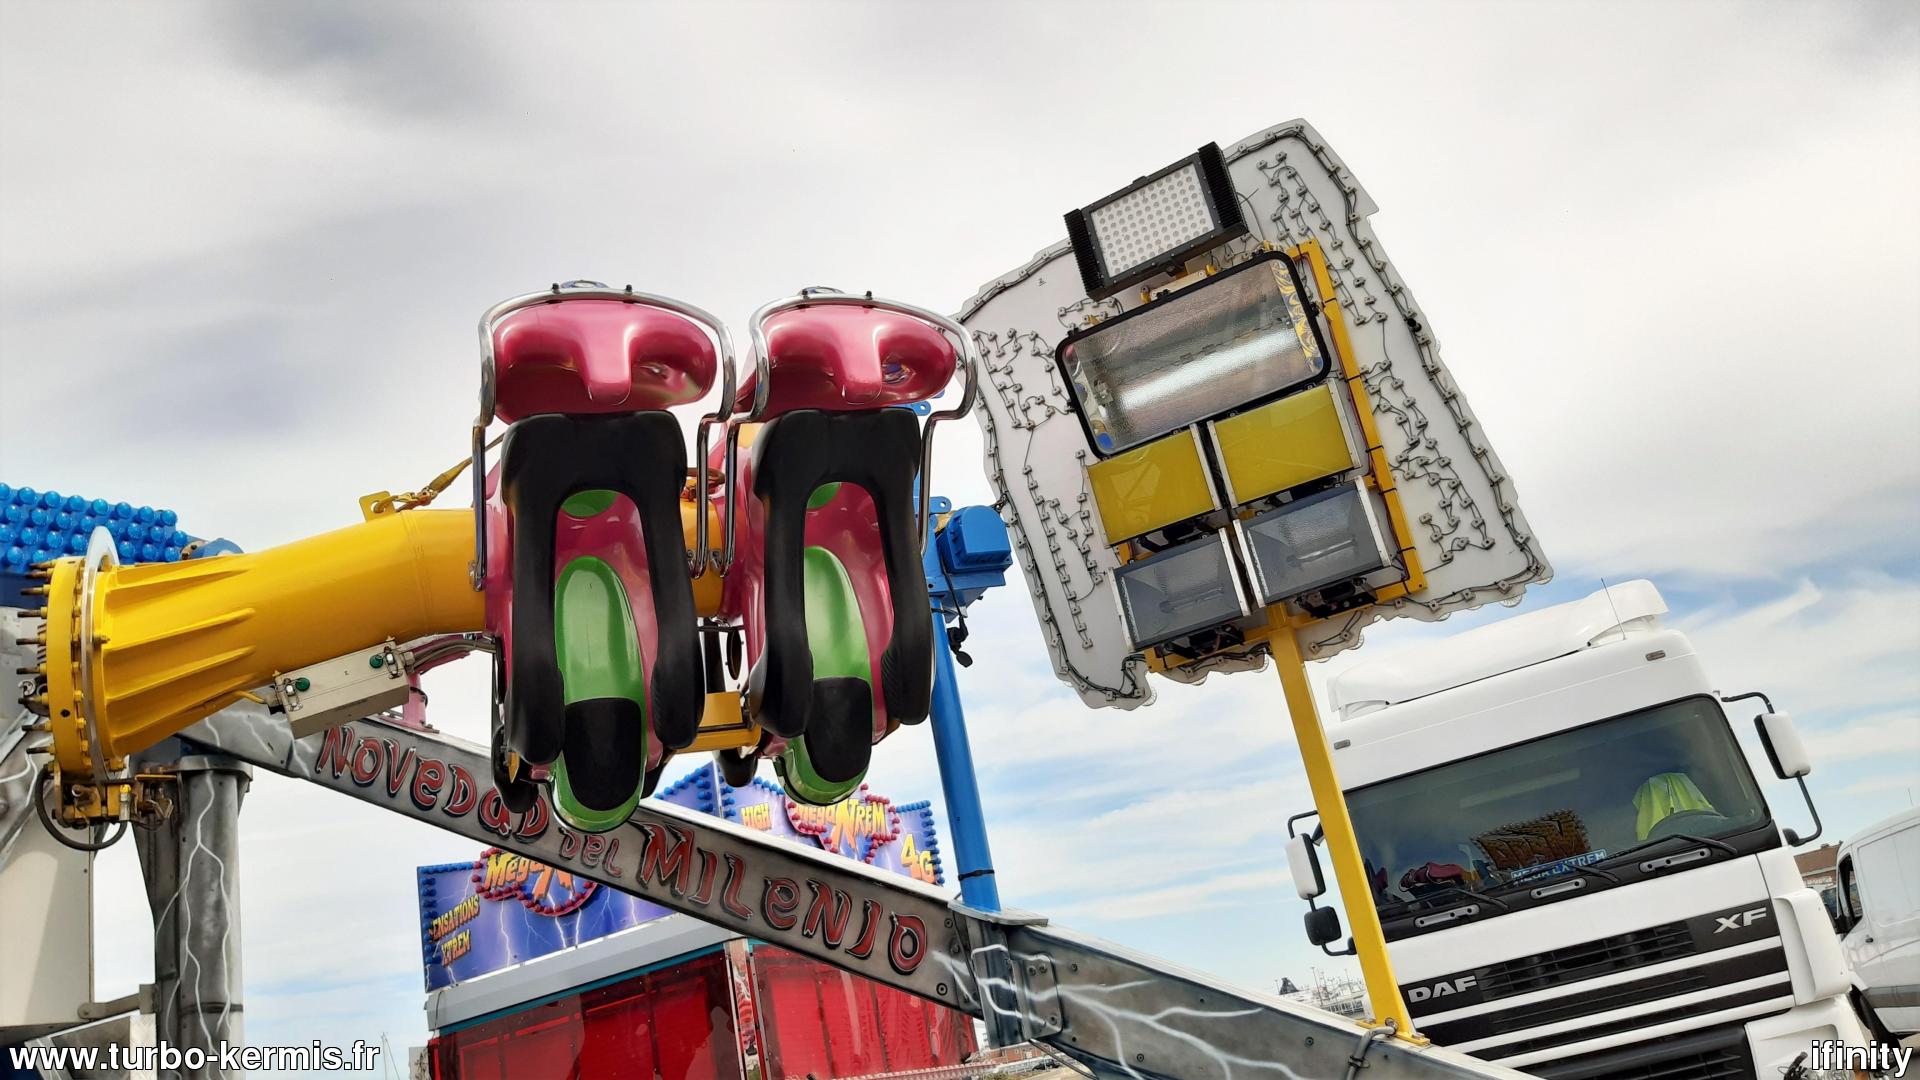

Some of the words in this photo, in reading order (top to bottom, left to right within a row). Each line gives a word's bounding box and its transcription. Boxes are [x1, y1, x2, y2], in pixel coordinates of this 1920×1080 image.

[741, 802, 772, 830] HIGH
[431, 895, 480, 941] ENSATIONS
[1713, 907, 1767, 934] XF
[441, 928, 471, 968] XTREM
[1408, 975, 1477, 1003] DAF
